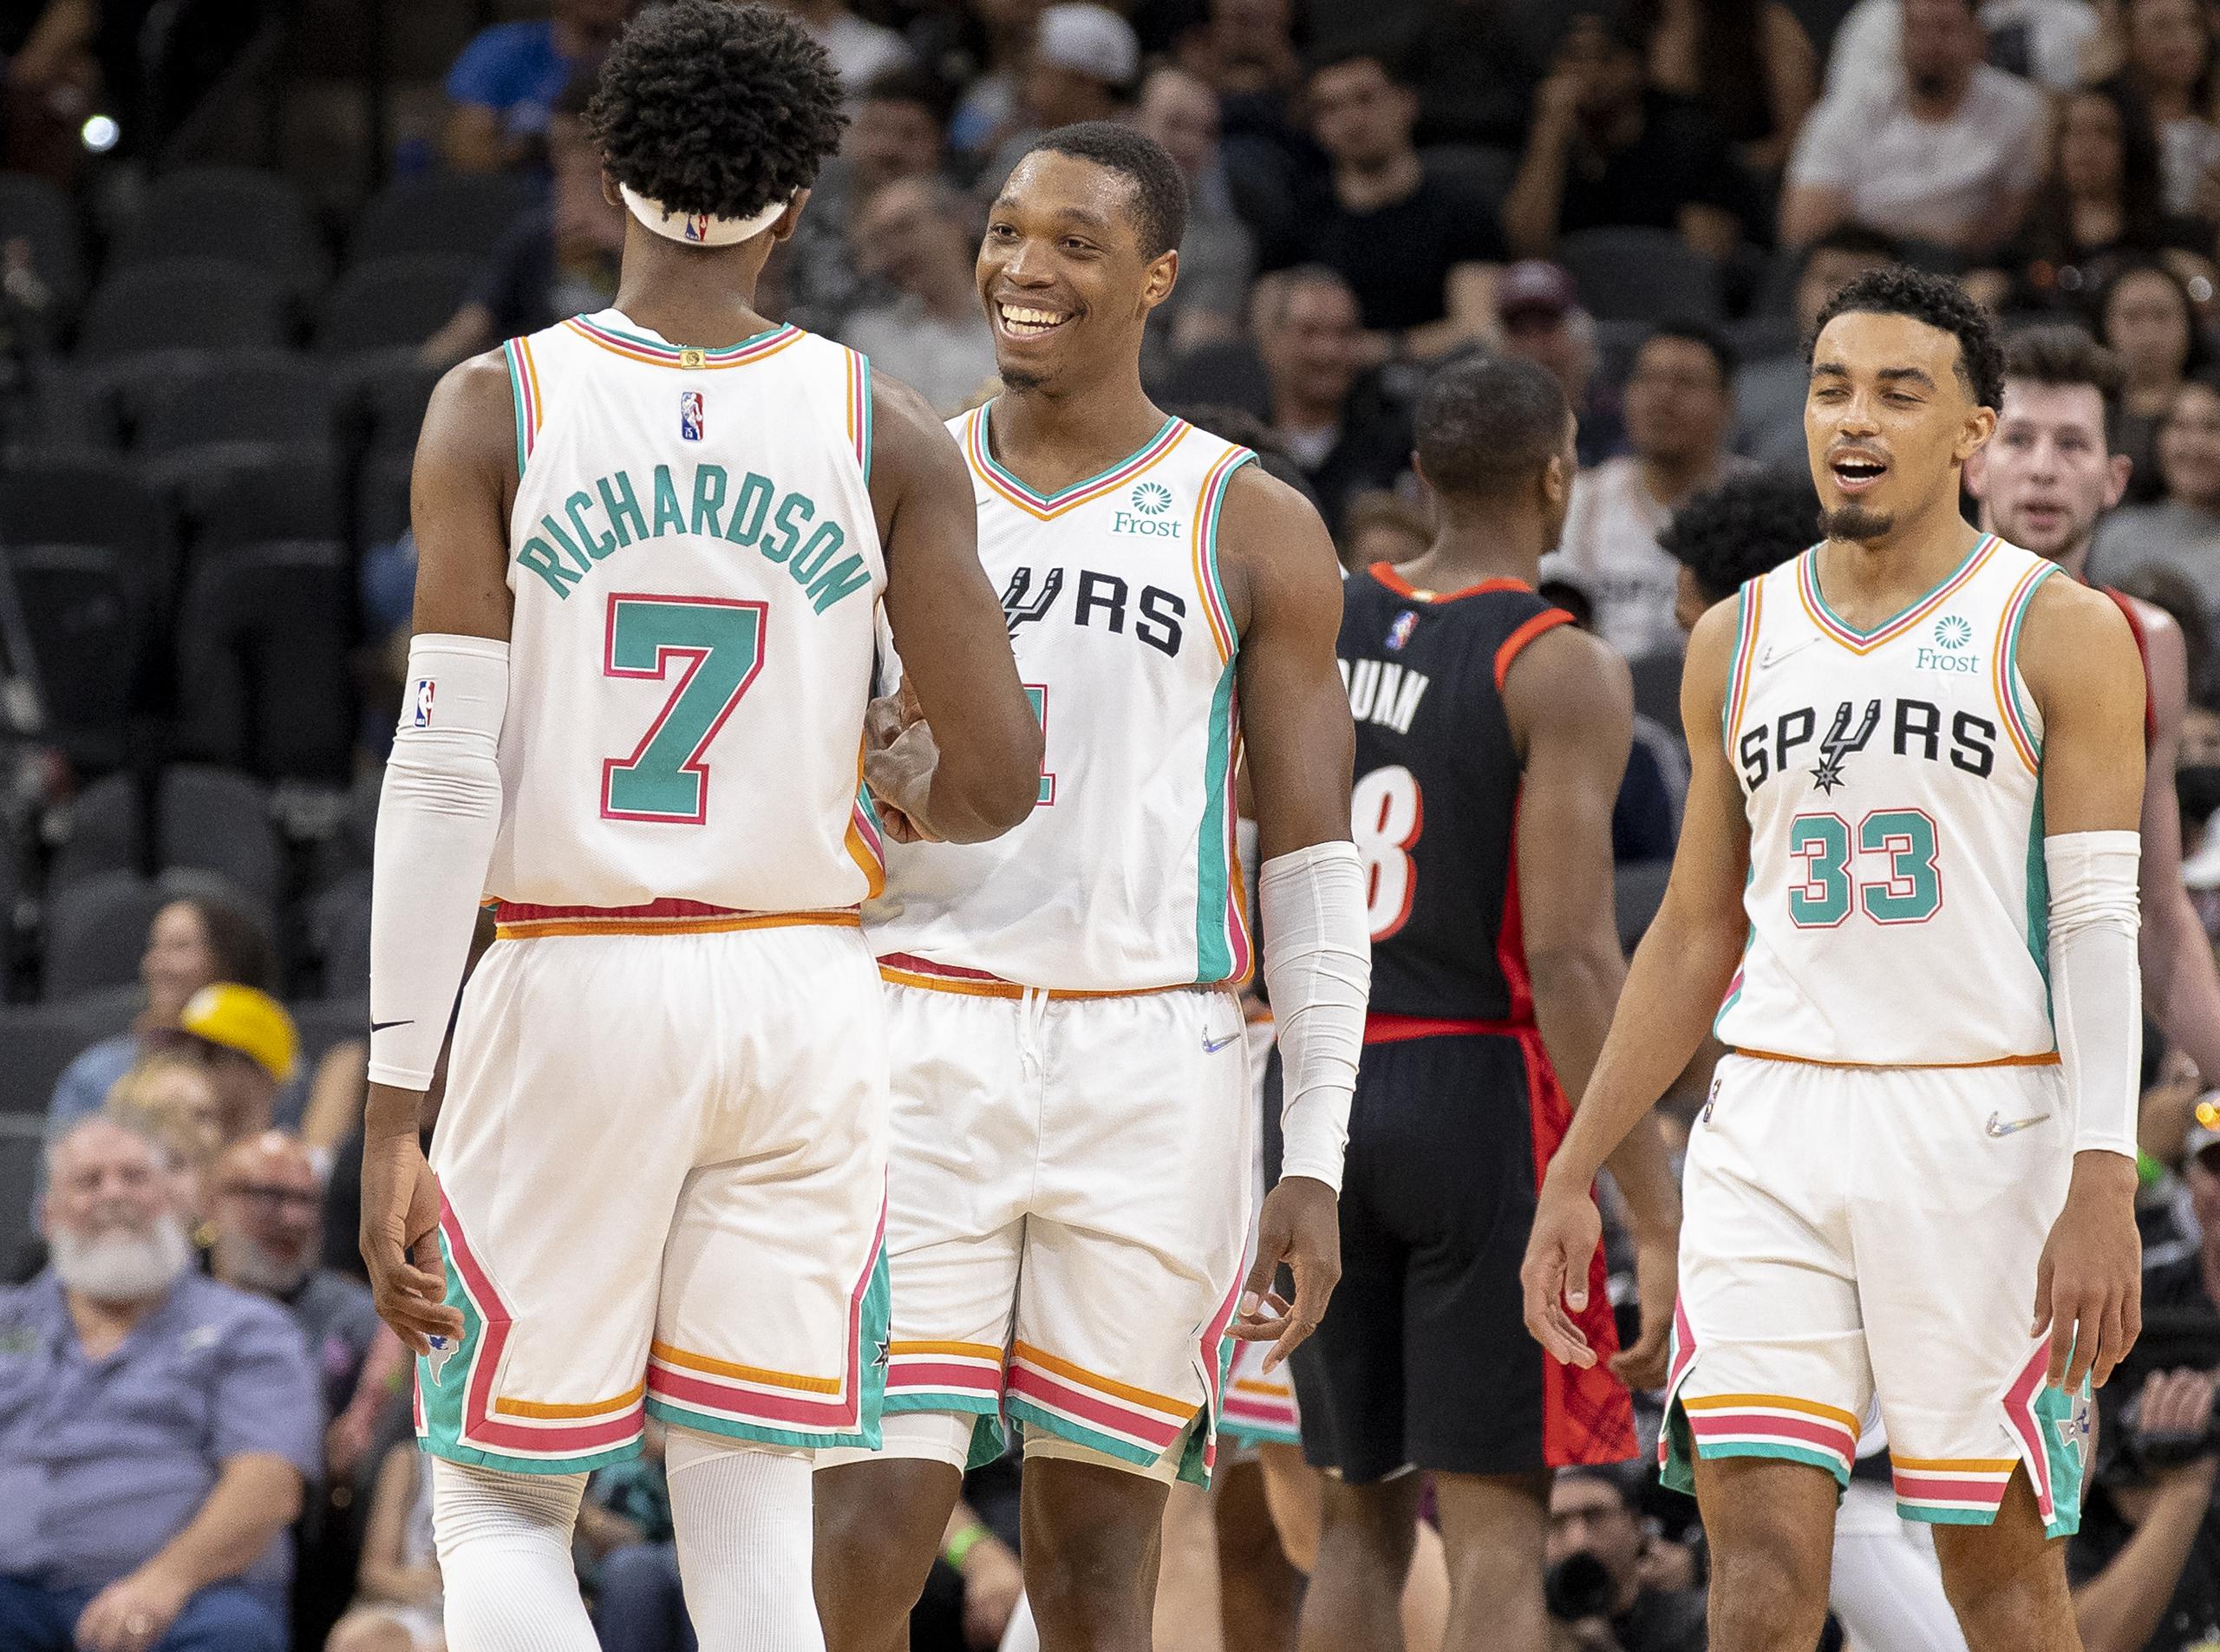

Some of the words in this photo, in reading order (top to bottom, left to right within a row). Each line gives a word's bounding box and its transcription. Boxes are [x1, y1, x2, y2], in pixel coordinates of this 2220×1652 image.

[516, 464, 871, 617] RICHARDSON
[1113, 511, 1182, 539] Frost
[1001, 567, 1186, 659] URS
[1916, 647, 1980, 674] Frost
[600, 592, 769, 826] 7
[1740, 697, 1997, 795] SPURS
[1788, 807, 1943, 930] 33
